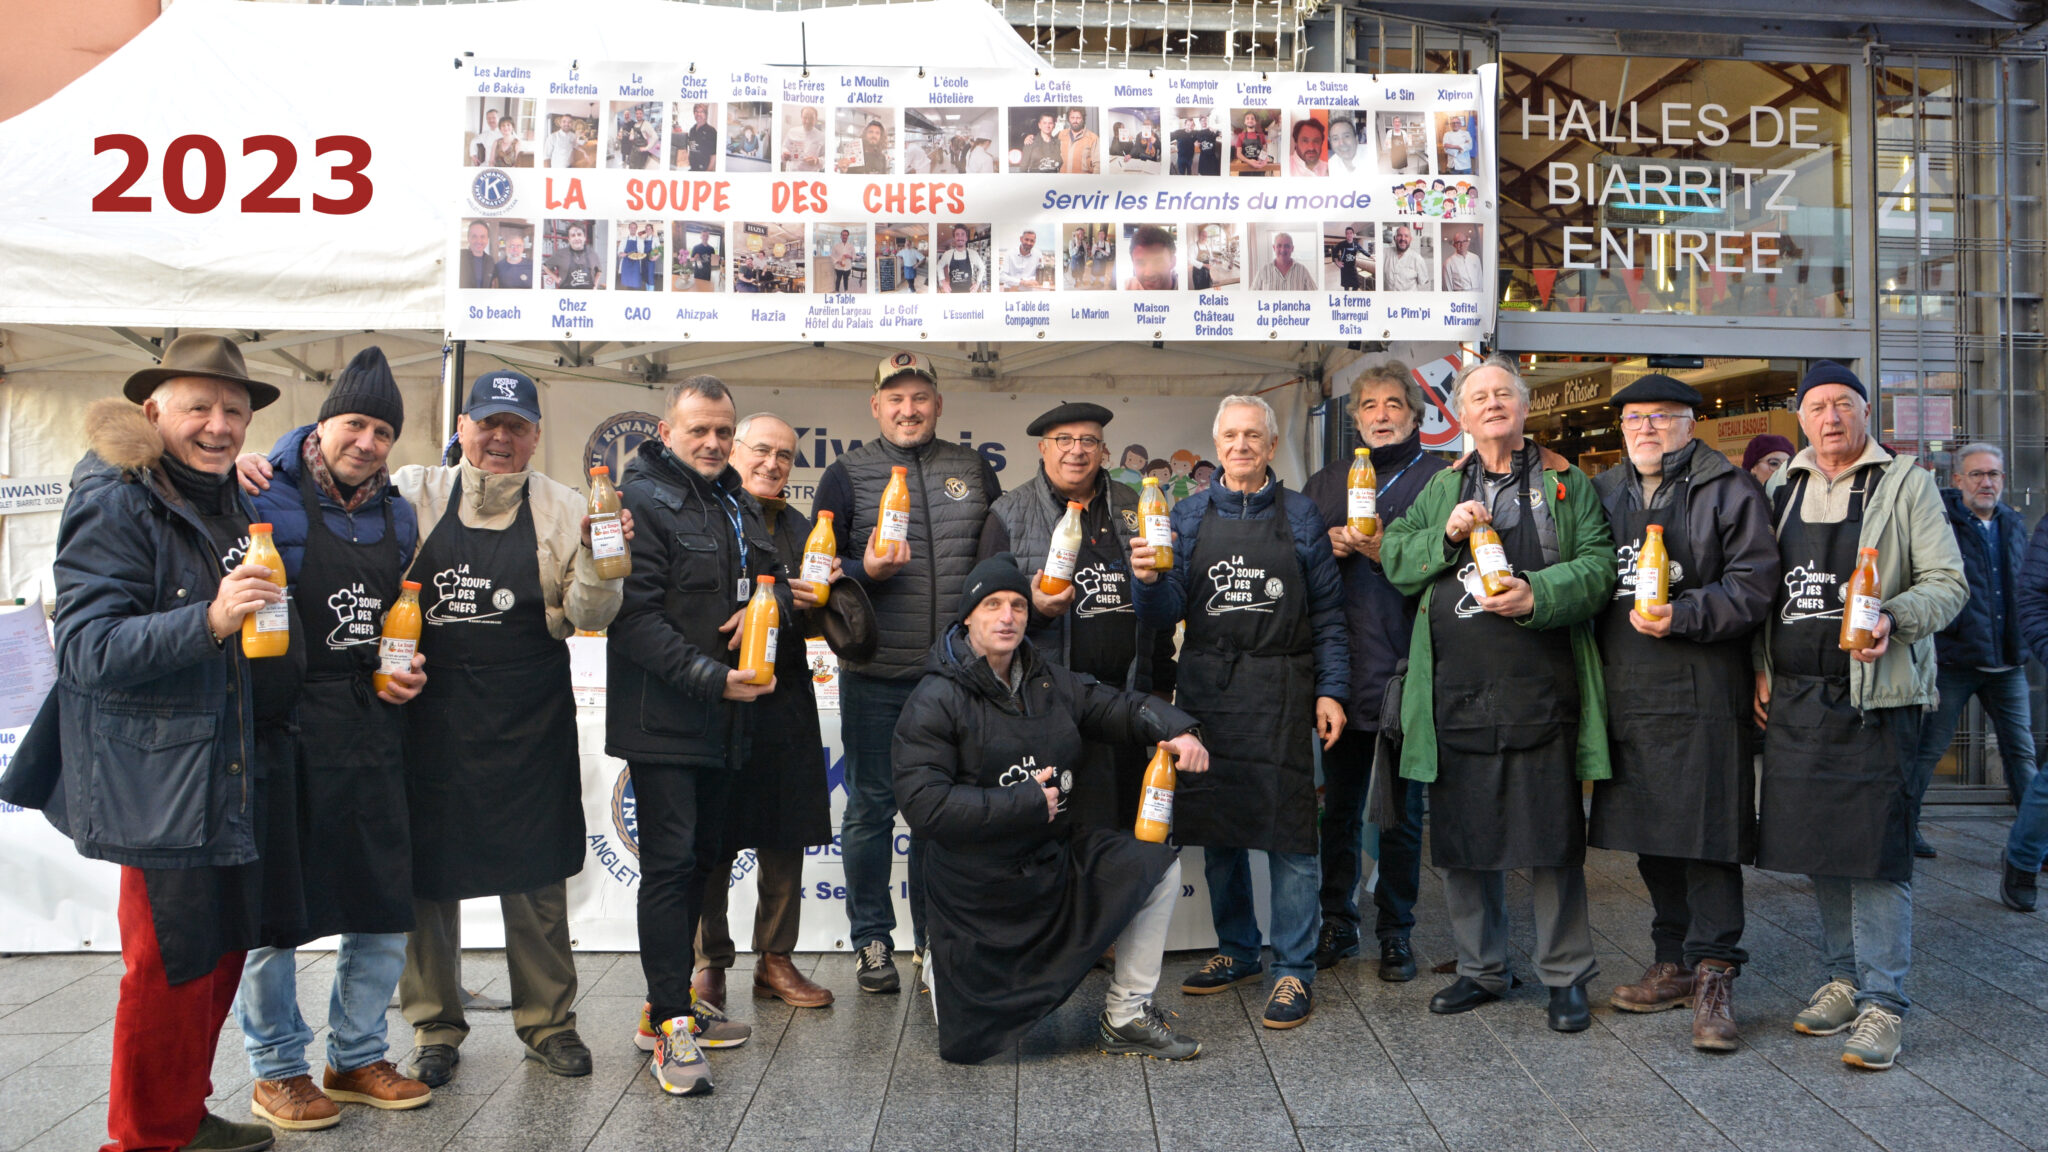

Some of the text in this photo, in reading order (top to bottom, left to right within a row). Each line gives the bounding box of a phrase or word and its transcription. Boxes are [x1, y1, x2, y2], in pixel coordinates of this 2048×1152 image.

[474, 66, 531, 78] Les Jardins
[569, 70, 579, 81] Le
[632, 73, 642, 83] Le
[682, 75, 707, 87] Chez
[732, 73, 767, 83] La Botte
[841, 76, 889, 87] Le Moulin
[934, 76, 968, 87] L'école
[478, 82, 490, 92] de
[550, 82, 597, 94] Briketenia
[784, 80, 796, 89] Les
[1035, 81, 1071, 91] Le Café
[1169, 78, 1218, 91] Le Komptoir
[1237, 83, 1271, 94] L'entre
[1307, 81, 1348, 91] Le Suisse
[619, 86, 654, 96] Marloe
[681, 87, 707, 99] Scott
[733, 87, 742, 96] de
[1115, 85, 1152, 96] Mômes
[1385, 88, 1414, 101] Le Sin
[848, 92, 883, 103] d'Alotz
[929, 93, 973, 104] Hôtelière
[1024, 92, 1082, 103] des Artistes
[1176, 94, 1213, 104] des Amis
[1243, 95, 1267, 106] deux
[1298, 95, 1360, 107] Arrantzaleak
[1521, 98, 1821, 149] HALLES DE
[1548, 162, 1797, 211] BIARRITZ
[544, 177, 587, 211] LA
[626, 179, 731, 213] SOUPE
[772, 182, 828, 214] DES
[863, 182, 965, 215] CHEFS
[1042, 189, 1371, 210] Servir les Enfants du monde
[1879, 152, 1943, 255] 4
[1563, 226, 1783, 274] ENTREE
[824, 293, 855, 304] La Table
[1199, 294, 1229, 306] Relais
[1329, 294, 1371, 307] La ferme
[559, 298, 587, 311] Chez
[885, 305, 917, 314] Le Golf
[1006, 301, 1049, 312] La Table des
[1134, 303, 1169, 312] Maison
[1258, 300, 1310, 313] La plancha
[1450, 302, 1478, 313] Sofitel
[469, 306, 520, 319] So beach
[625, 307, 651, 320] CAO
[676, 309, 718, 321] Ahizpak
[752, 309, 785, 321] Hazia
[842, 306, 871, 317] Largeau
[1072, 308, 1109, 319] Le Marion
[1194, 310, 1234, 322] Château
[1388, 307, 1398, 318] Le
[552, 315, 593, 328] Mattin
[805, 317, 873, 328] Hôtel du Palais
[880, 316, 922, 326] du Phare
[1005, 314, 1049, 327] Compagnons
[1137, 314, 1166, 324] Plaisir
[1257, 314, 1310, 328] du pêcheur
[1444, 315, 1481, 326] Miramar
[1195, 324, 1233, 336] Brindos
[1718, 417, 1767, 437] GATEAUX BASQUES
[0, 482, 62, 498] IWANIS
[1232, 555, 1244, 566] LA
[458, 564, 470, 574] LA
[1094, 563, 1106, 572] LA
[1102, 573, 1126, 582] SOUPE
[1236, 568, 1266, 579] SOUPE
[1808, 573, 1836, 584] SOUPE
[352, 583, 365, 594] LA
[460, 577, 492, 589] SOUPE
[1102, 584, 1117, 592] DES
[1234, 580, 1251, 590] DES
[458, 589, 475, 600] DES
[1096, 594, 1121, 604] CHEFS
[1224, 592, 1252, 602] CHEFS
[359, 597, 382, 609] SOUPE
[448, 601, 477, 614] CHEFS
[1796, 598, 1824, 609] CHEFS
[357, 610, 372, 620] DES
[348, 624, 374, 635] CHEFS
[1023, 756, 1035, 767] LA
[587, 833, 640, 888] ANGLET
